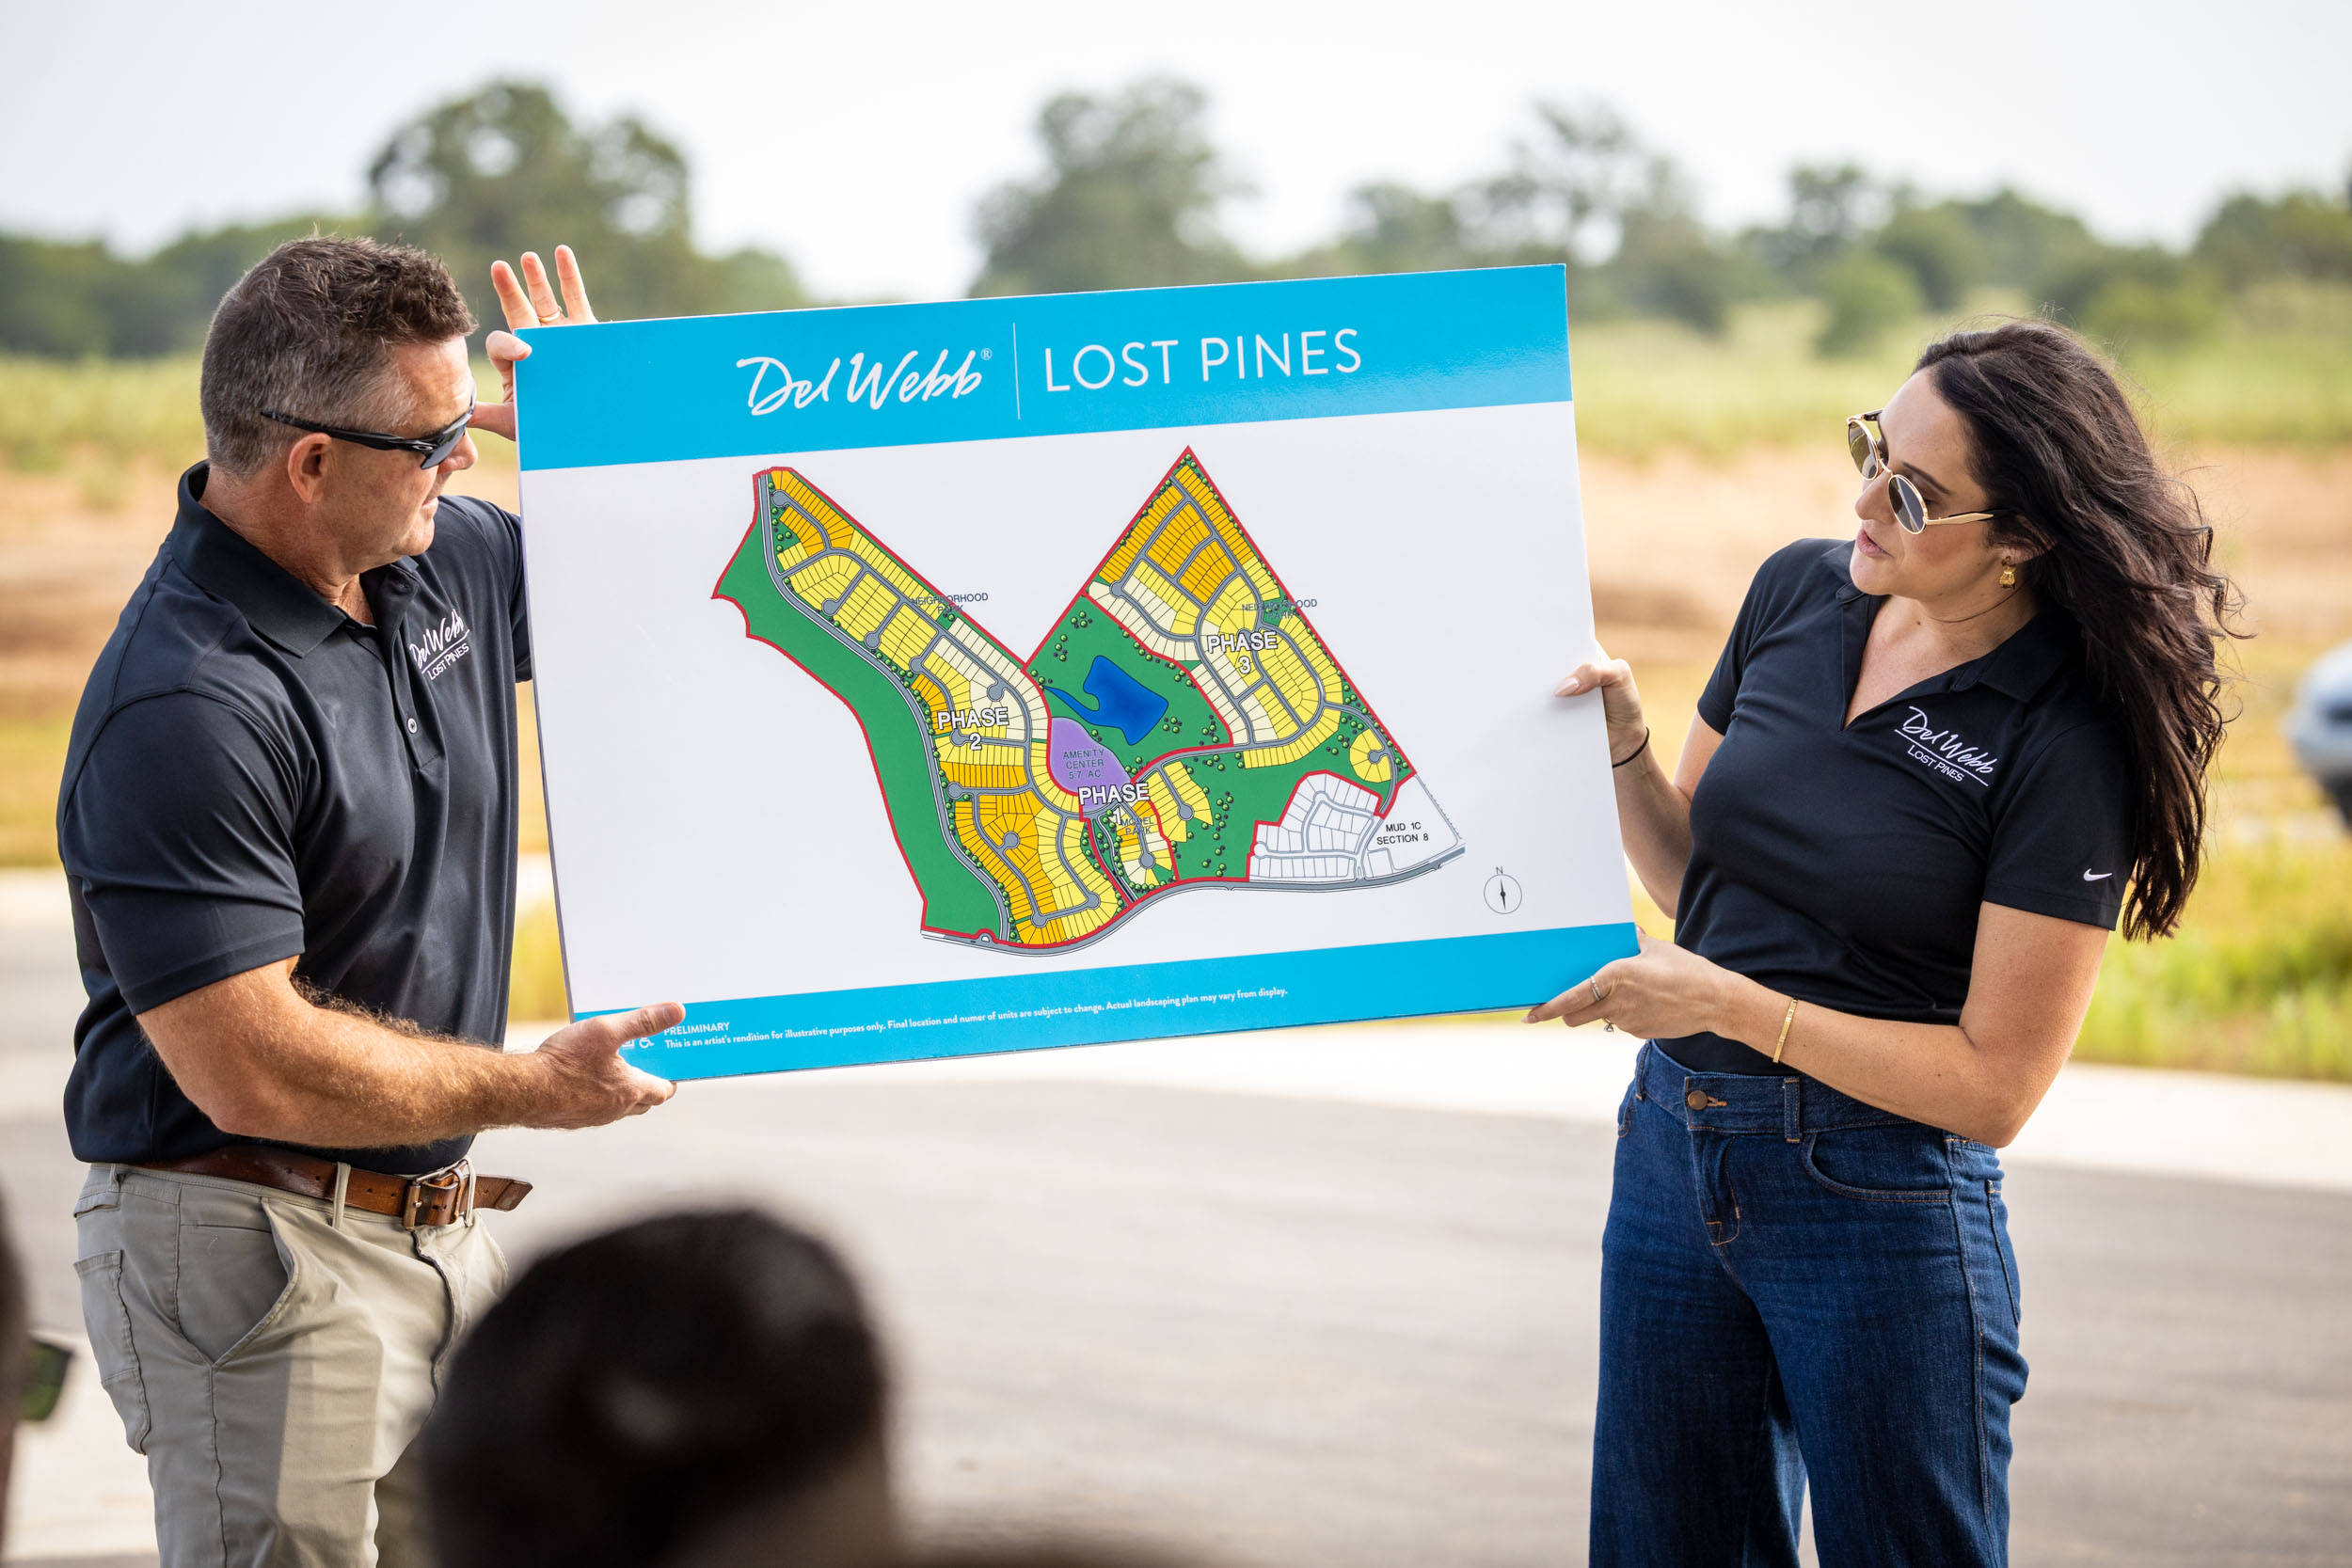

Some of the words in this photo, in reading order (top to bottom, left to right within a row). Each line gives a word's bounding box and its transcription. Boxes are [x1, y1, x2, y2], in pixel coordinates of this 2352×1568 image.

[1044, 339, 1179, 392] LOST
[1200, 328, 1362, 382] PINES
[736, 356, 840, 416] Del
[1208, 631, 1278, 654] PHASE
[427, 660, 448, 680] LOST
[445, 642, 469, 666] PINES
[1238, 655, 1251, 674] 3
[937, 707, 1009, 730] PHASE
[968, 732, 982, 751] 2
[1901, 705, 1949, 745] Del
[1939, 734, 1998, 774] Webb
[1063, 749, 1104, 759] AMENITY
[1066, 759, 1104, 768] CENTER
[1907, 744, 1937, 767] LOST
[1933, 760, 1965, 782] PINES
[1068, 771, 1082, 780] 5.7
[1089, 769, 1104, 778] AC.
[1078, 783, 1150, 806] PHASE
[1112, 807, 1122, 826] 1
[1385, 822, 1406, 832] MUD
[1411, 821, 1422, 831] 1C
[1376, 834, 1419, 846] SECTION
[1422, 832, 1429, 842] 8
[1496, 865, 1503, 874] N
[664, 1038, 683, 1050] This
[684, 1037, 691, 1048] is
[692, 1038, 703, 1047] an
[733, 1032, 771, 1043] rendition
[771, 1030, 784, 1039] for
[785, 1027, 828, 1039] illustrative
[829, 1025, 865, 1037] purposes
[866, 1022, 886, 1034] only.
[887, 1019, 908, 1030] Final
[909, 1017, 942, 1027] location
[943, 1014, 958, 1024] and
[959, 1014, 985, 1023] numer
[987, 1011, 996, 1021] of
[997, 1010, 1018, 1020] units
[1033, 1006, 1062, 1019] subject
[1063, 1006, 1073, 1014] to
[1073, 1004, 1104, 1014] change.
[1105, 1000, 1133, 1010] Actual
[1134, 996, 1181, 1008] landscaping
[1182, 995, 1199, 1006] plan
[1200, 994, 1217, 1005] may
[1218, 991, 1236, 1003] vary
[1236, 990, 1257, 999] from
[1258, 987, 1288, 999] display.
[663, 1022, 731, 1037] PRELIMINARY
